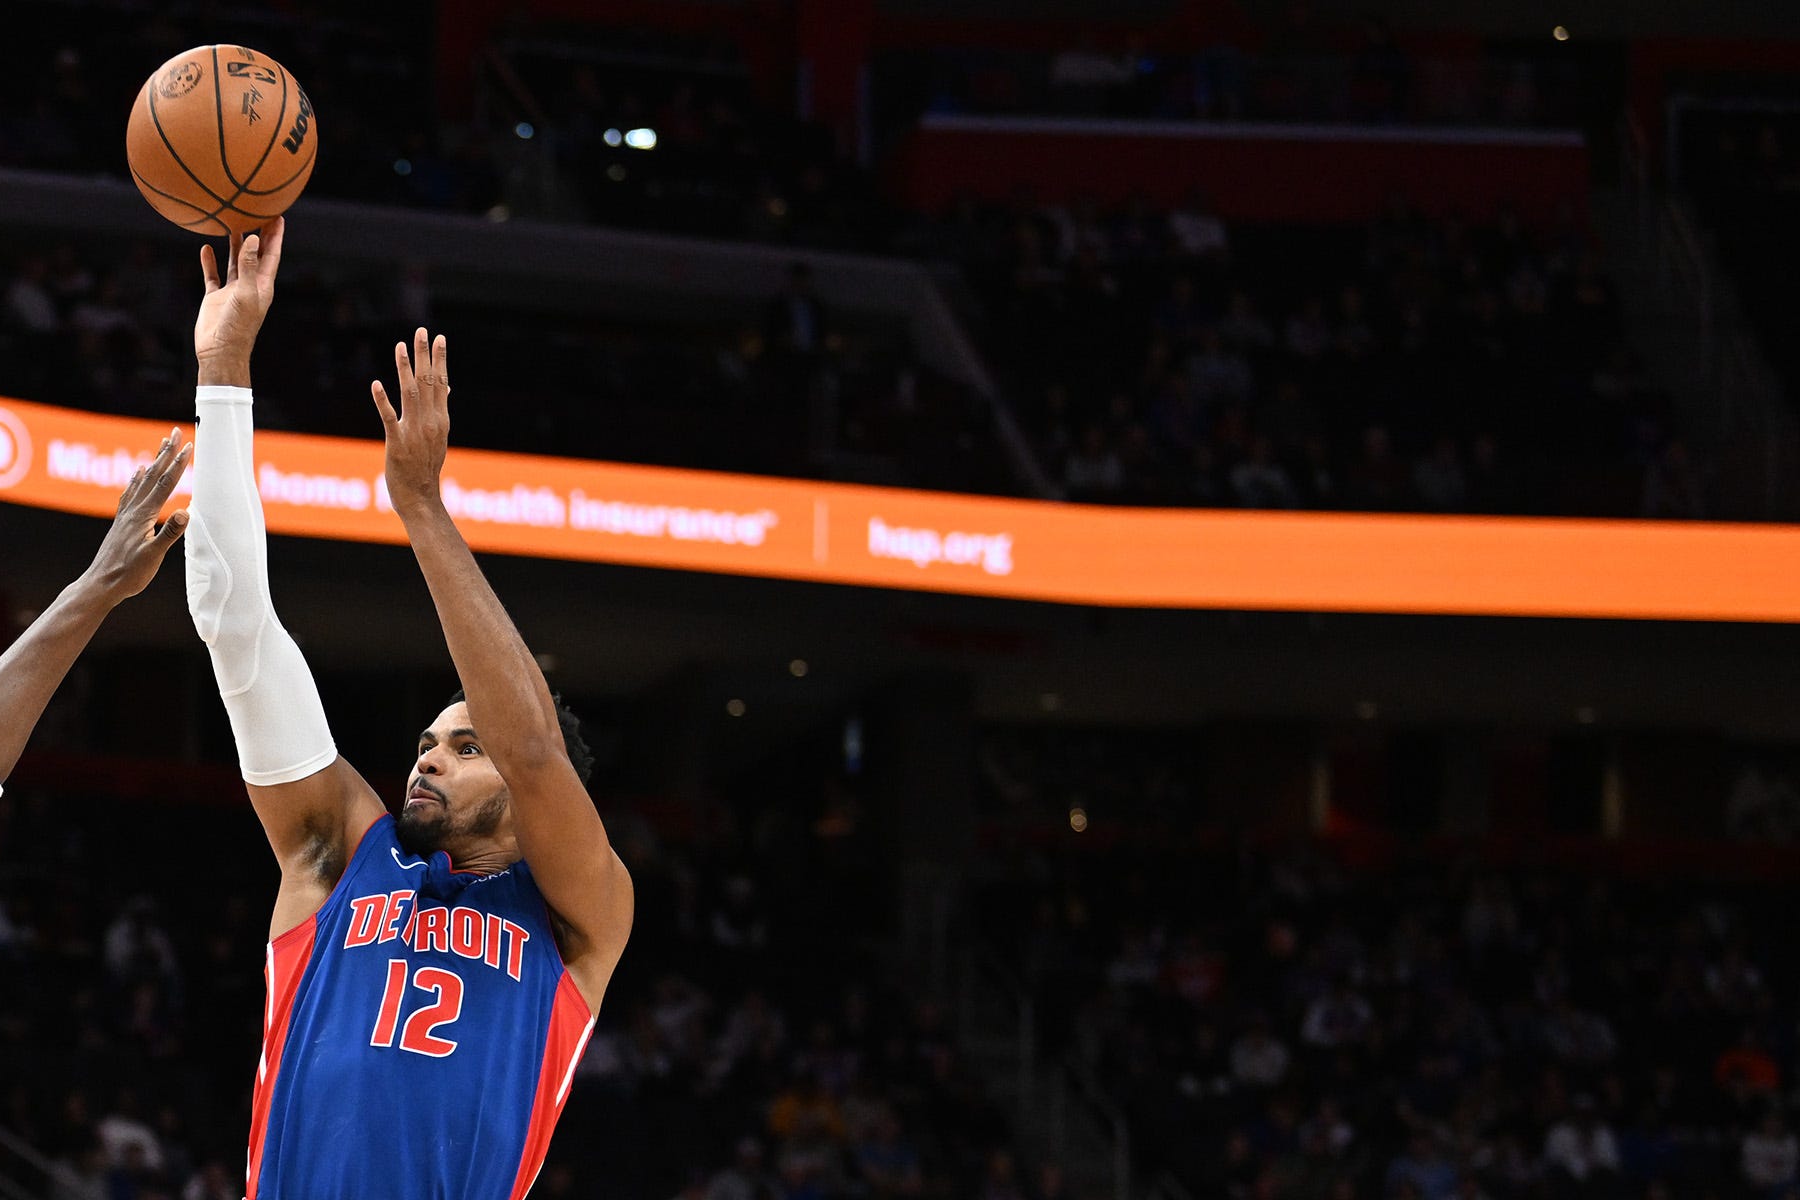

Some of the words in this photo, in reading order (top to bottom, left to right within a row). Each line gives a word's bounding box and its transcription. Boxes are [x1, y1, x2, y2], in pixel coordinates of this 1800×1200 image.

[258, 461, 371, 512] home
[440, 475, 566, 528] health
[868, 516, 1014, 576] hap.org
[369, 958, 465, 1058] 12
